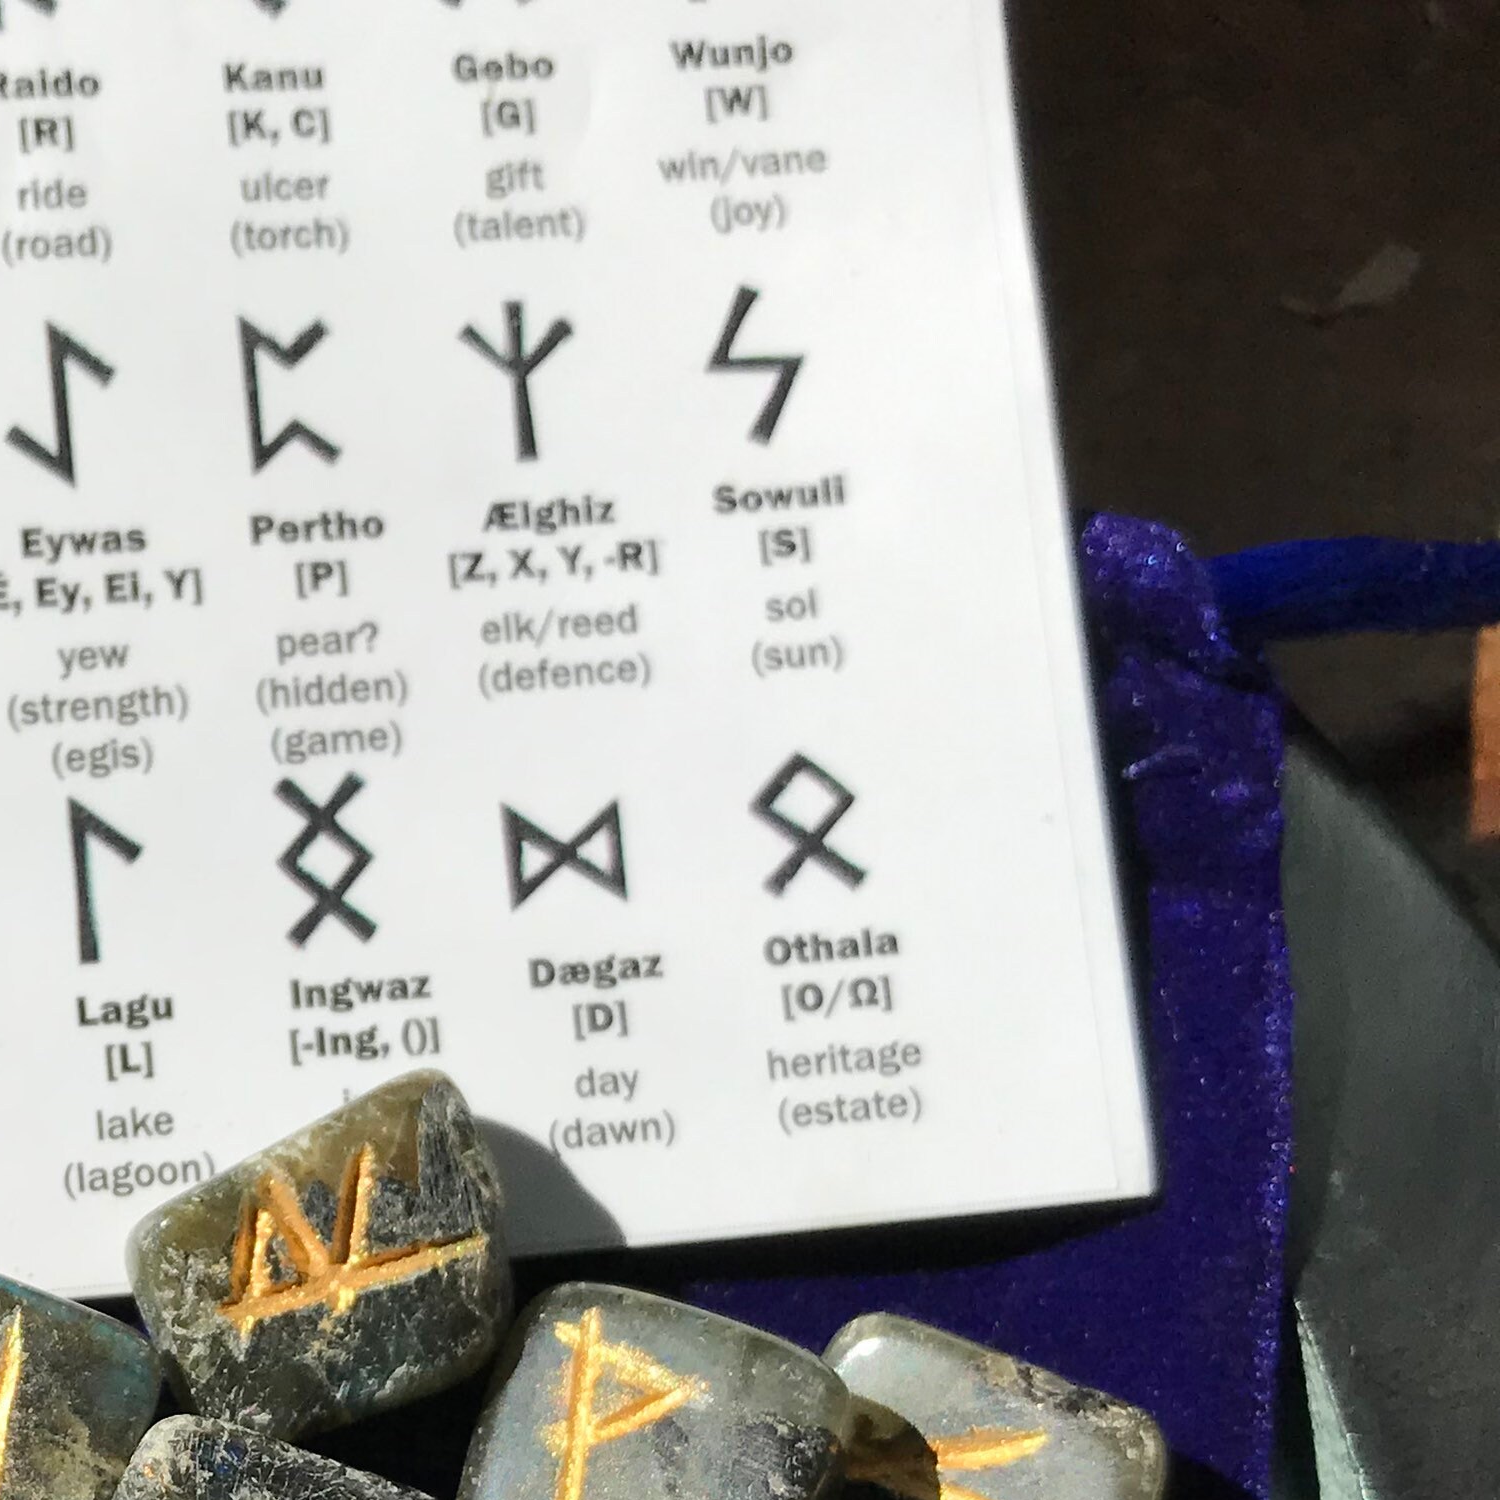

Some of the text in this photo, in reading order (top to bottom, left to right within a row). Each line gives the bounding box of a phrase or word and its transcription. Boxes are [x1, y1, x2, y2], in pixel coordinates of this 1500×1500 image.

[452, 51, 555, 83] Gebo
[669, 33, 795, 73] Wunjo
[223, 62, 324, 92] Kanu
[481, 98, 536, 137] [G]
[705, 84, 768, 123] [W]
[19, 116, 75, 153] [R]
[227, 106, 331, 147] [K, C]
[240, 171, 330, 203] ulcer
[485, 158, 545, 200] gift
[657, 148, 828, 185] win/vane
[17, 177, 89, 211] ride
[709, 193, 788, 235] (joy)
[1, 225, 113, 266] (road)
[230, 217, 350, 258] (torch)
[453, 206, 586, 249] (talent)
[20, 527, 147, 565] Eywas
[249, 510, 385, 546] Pertho
[759, 526, 812, 566] [S]
[295, 559, 349, 599] [P]
[448, 539, 659, 589] [Z, X, Y, -R]
[35, 576, 92, 614] Ey,
[164, 567, 203, 606] Y]
[765, 587, 819, 623] sol
[276, 620, 379, 666] pear?
[480, 602, 639, 647] elk/reed
[57, 644, 130, 681] yew
[478, 653, 652, 700] (defence)
[751, 635, 845, 678] (sun)
[7, 684, 189, 733] (strength)
[255, 670, 409, 715] (hidden)
[51, 737, 154, 780] (egis)
[270, 720, 403, 766] (game)
[764, 928, 900, 967] Othala
[76, 994, 174, 1030] Lagu
[290, 975, 431, 1013] Ingwaz
[572, 1000, 629, 1042] [D]
[105, 1041, 155, 1083] [L]
[766, 1040, 923, 1081] heritage
[574, 1066, 639, 1102] day
[95, 1107, 174, 1141] lake
[778, 1087, 923, 1135] (estate)
[549, 1108, 676, 1157] (dawn)
[64, 1150, 216, 1202] (lagoon)
